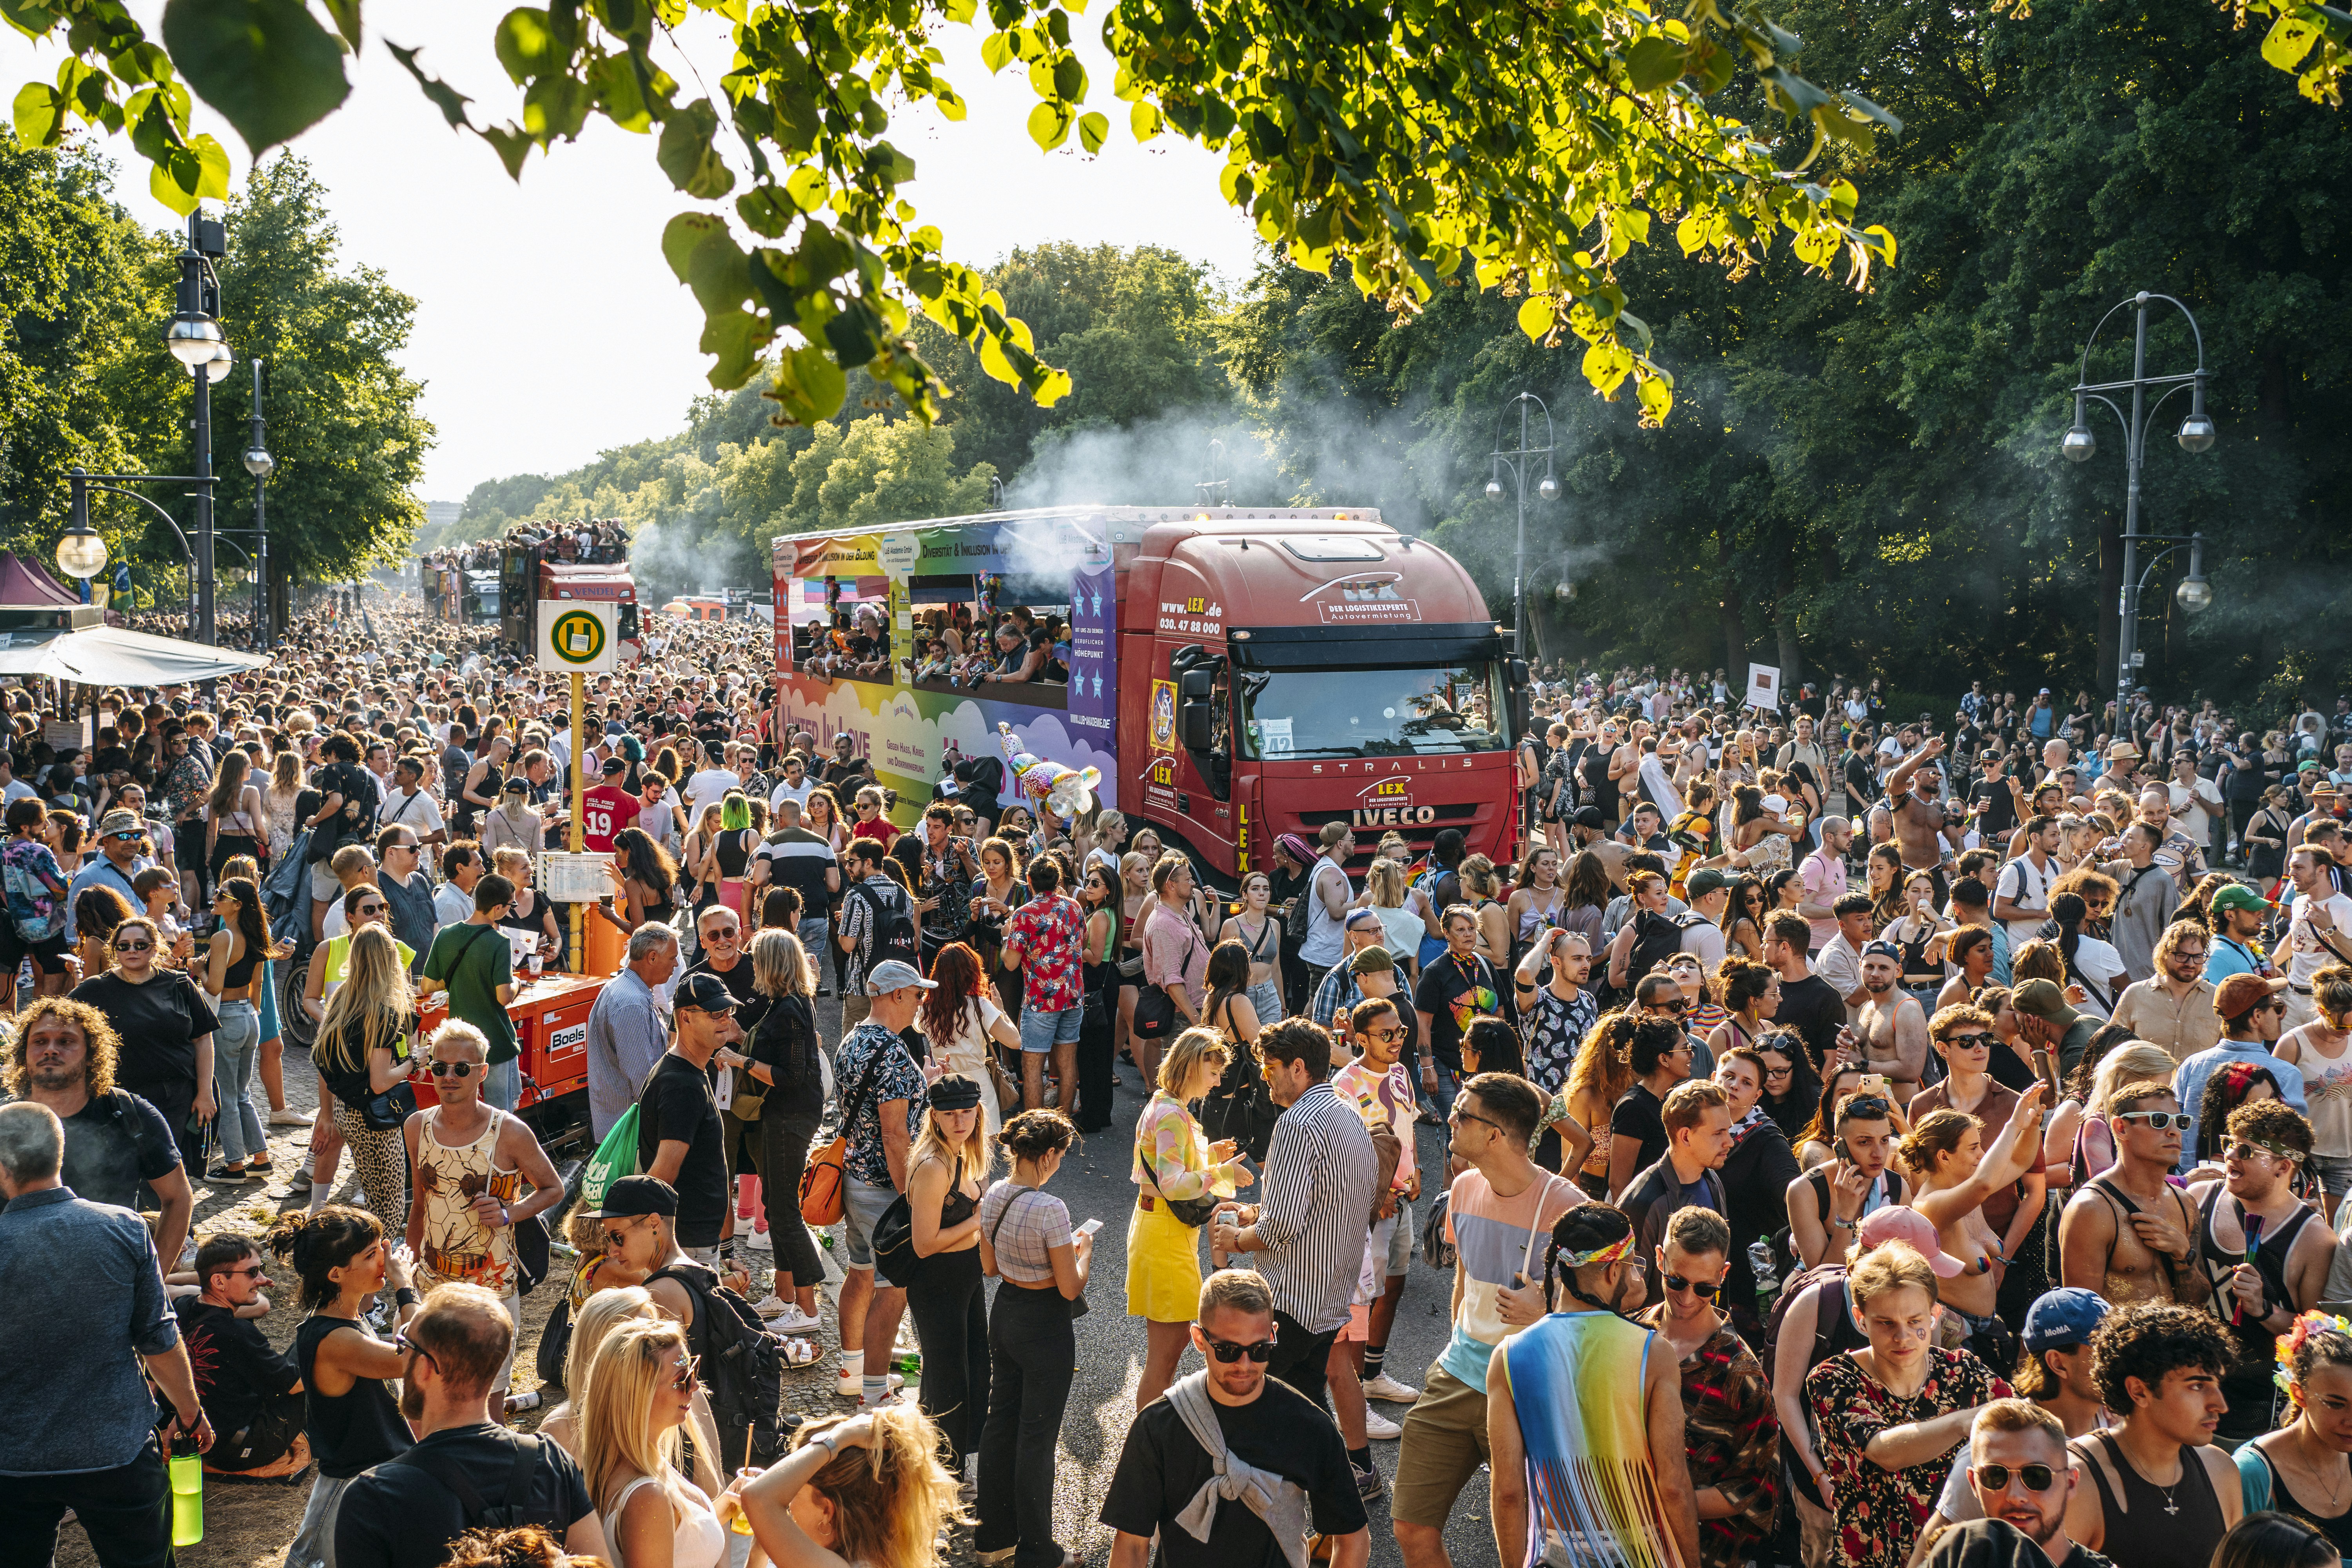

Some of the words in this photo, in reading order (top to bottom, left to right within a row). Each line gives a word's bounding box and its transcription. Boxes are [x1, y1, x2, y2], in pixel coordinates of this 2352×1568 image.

[855, 548, 875, 561] BILDUNG
[575, 588, 615, 596] VENDEL
[1345, 604, 1408, 612] LOGISTIKEXPERTE
[1160, 618, 1176, 630] 030.
[1178, 620, 1189, 631] 47
[1190, 621, 1201, 633] 88
[1203, 622, 1220, 634] 000
[1074, 648, 1103, 658] HÖHEPUNKT
[887, 739, 898, 751] GEGEN
[913, 748, 924, 757] KRIEG
[1269, 737, 1291, 757] 42
[1312, 758, 1472, 774] STRALIS
[1154, 765, 1173, 788] LEX
[1378, 783, 1405, 795] LEX
[1149, 794, 1174, 807] Autovermietung
[587, 811, 611, 836] 19
[1353, 806, 1434, 827] IVECO
[1239, 804, 1249, 873] LEX
[553, 1028, 584, 1047] Boels
[573, 1044, 584, 1052] RENTAL
[2044, 1324, 2071, 1336] MoMA
